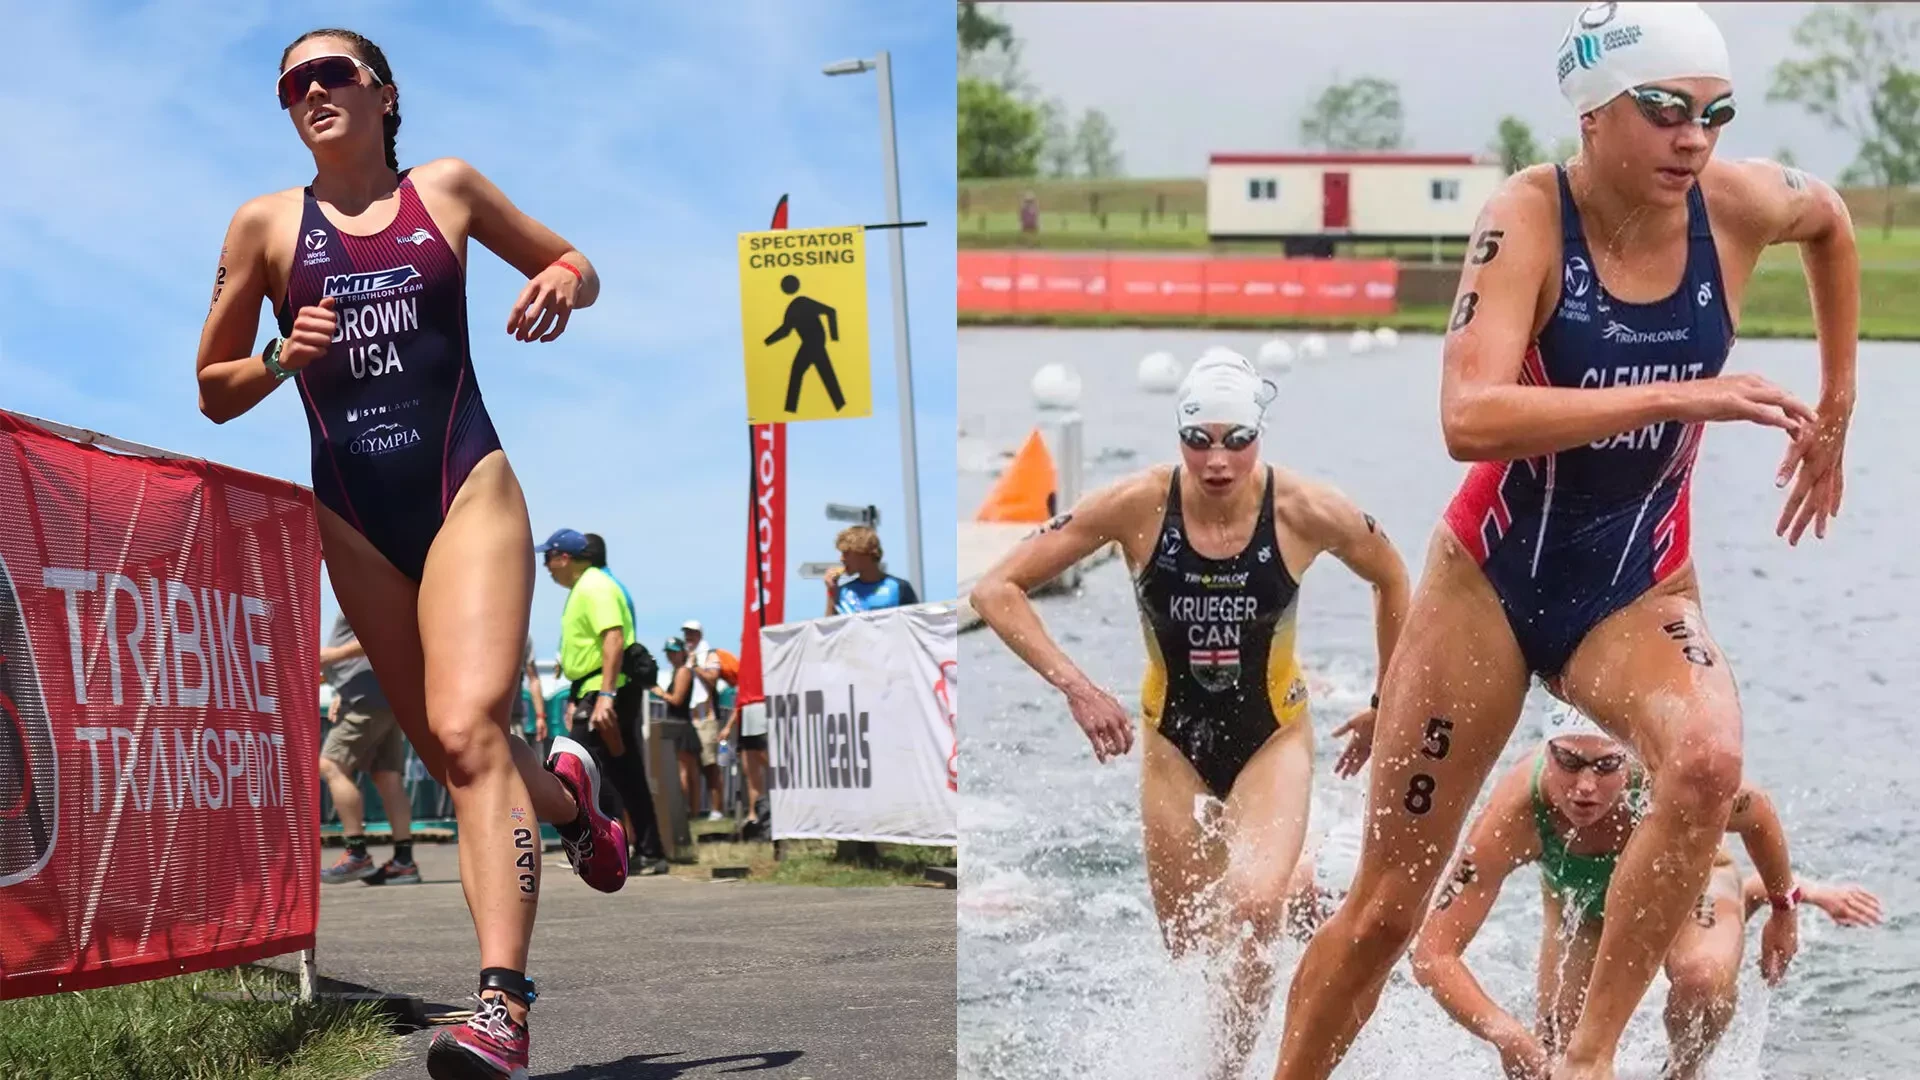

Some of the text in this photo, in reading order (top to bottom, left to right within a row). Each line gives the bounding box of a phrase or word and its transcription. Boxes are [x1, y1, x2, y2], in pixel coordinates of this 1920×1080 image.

[306, 251, 326, 259] World
[750, 232, 853, 251] SPECTATOR
[303, 256, 331, 267] Triathlon
[749, 249, 855, 269] CROSSING
[347, 289, 395, 303] TRIATHLON
[398, 283, 424, 294] TEAM
[331, 297, 419, 343] BROWN
[349, 341, 404, 379] USA
[350, 428, 421, 455] OLYMPIA
[751, 422, 775, 613] TOYOTA
[1169, 595, 1258, 622] KRUEGER
[43, 566, 277, 714] TRIBIKE
[1188, 624, 1241, 647] CAN
[805, 684, 871, 789] Meals
[75, 727, 286, 813] TRANSPORT
[513, 828, 536, 894] 243
